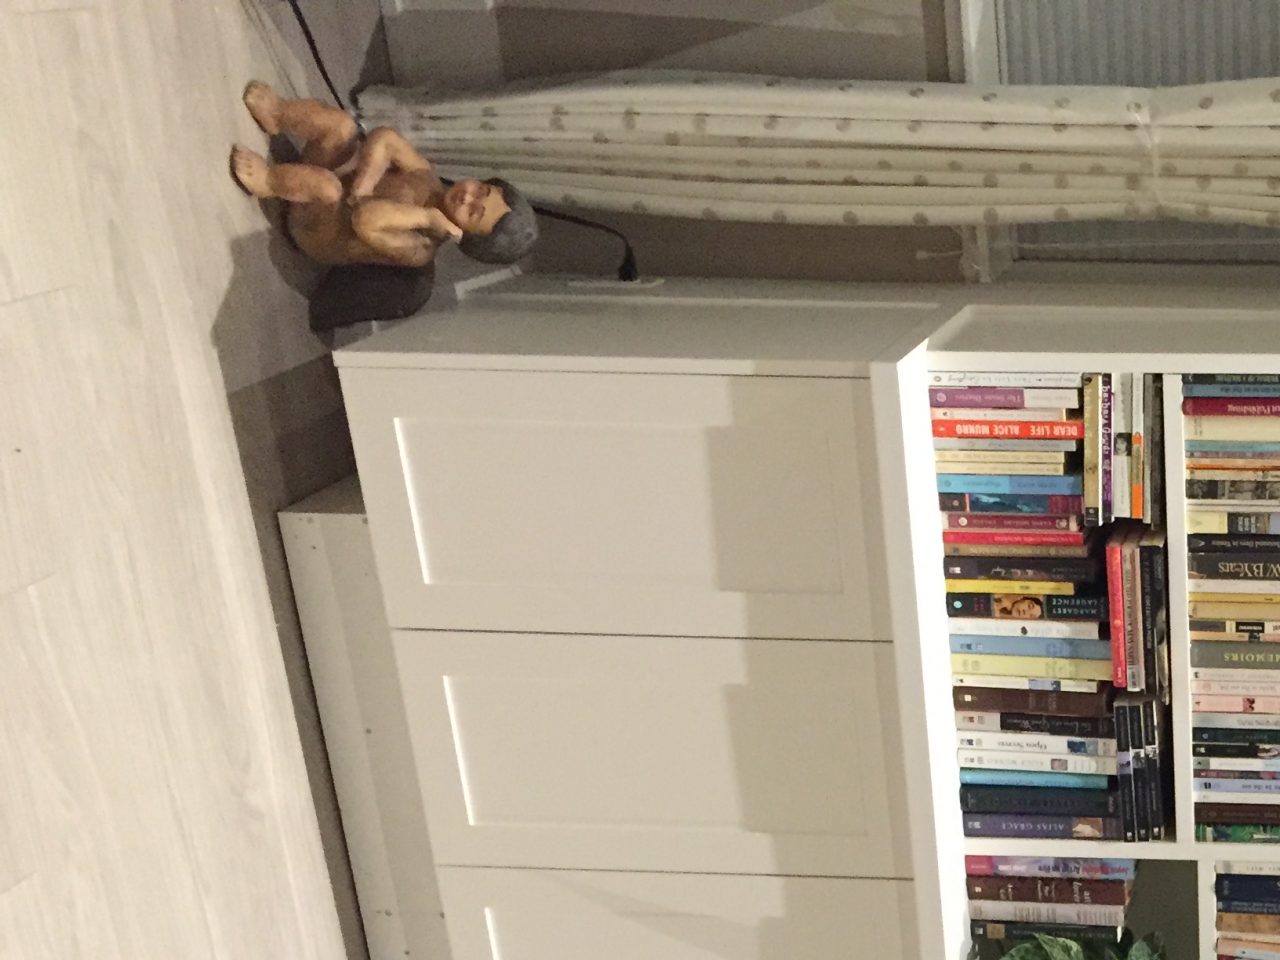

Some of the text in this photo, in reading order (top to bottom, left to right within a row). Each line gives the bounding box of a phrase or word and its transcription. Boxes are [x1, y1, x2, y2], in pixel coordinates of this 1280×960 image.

[1227, 403, 1270, 414] Publishing
[955, 424, 1078, 436] DEAR LIFE ALICE MUNRO
[1051, 597, 1098, 605] LAURENCE
[1001, 822, 1065, 832] ALIAS GRACE
